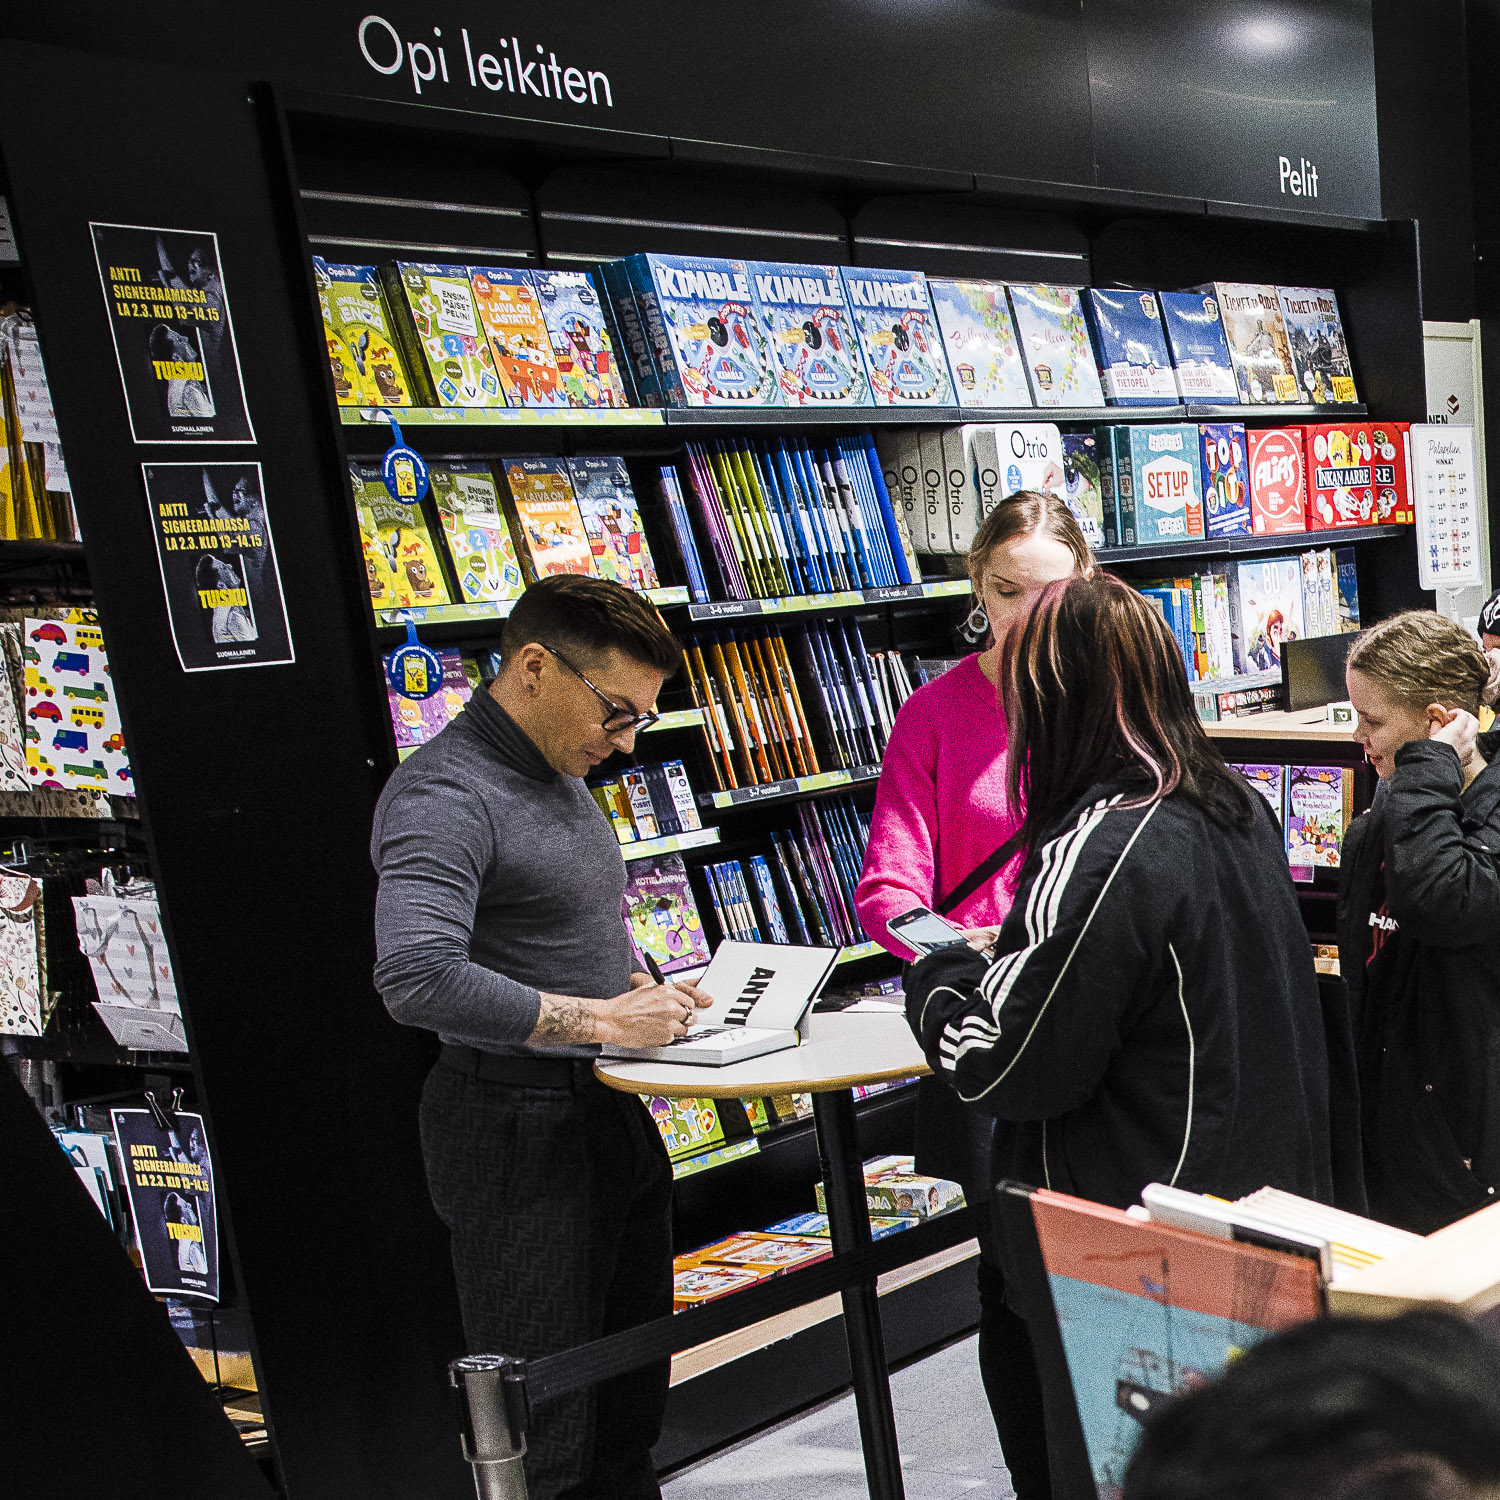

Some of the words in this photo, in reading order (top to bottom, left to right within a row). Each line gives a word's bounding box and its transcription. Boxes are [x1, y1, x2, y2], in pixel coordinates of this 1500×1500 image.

[358, 15, 450, 94] Opi
[463, 28, 614, 108] leikiten
[1278, 155, 1320, 198] Pelit
[109, 266, 142, 283] ANTTI
[683, 262, 716, 271] ORIGINAL
[780, 268, 811, 277] ORIGINAL
[655, 267, 751, 302] KIMBLE
[871, 273, 899, 281] ORIGINAL
[113, 284, 208, 304] SIGNEERAAMASSA
[754, 272, 844, 307] KIMBLE
[849, 278, 929, 309] KIMBLE
[117, 302, 131, 317] LA
[133, 303, 152, 318] 2.3.
[153, 304, 173, 319] KLO
[488, 302, 516, 314] LAIVA
[517, 304, 532, 314] ON
[1283, 297, 1309, 315] TICKET
[1317, 296, 1336, 314] RIDE
[489, 312, 536, 325] LASTATTU
[152, 360, 205, 382] TUISKU
[1116, 377, 1150, 389] TIETOPELI
[1275, 379, 1286, 399] 10
[1333, 381, 1343, 400] 10
[1010, 429, 1048, 459] Otrio
[1207, 437, 1243, 471] TOP
[1147, 470, 1189, 499] SETUP
[1318, 470, 1344, 487] INKAN
[1344, 468, 1370, 486] AARRE
[902, 466, 918, 512] Otrio
[925, 469, 941, 515] Otrio
[949, 469, 965, 516] Otrio
[159, 502, 189, 517] ANTTI
[162, 518, 251, 534] SIGNEERAAMASSA
[165, 537, 179, 551] LA
[179, 536, 199, 550] 2.3.
[199, 535, 218, 549] KLO
[1261, 562, 1280, 593] 80
[198, 588, 248, 609] TUISKU
[216, 649, 256, 658] SUOMALAINEN
[723, 966, 777, 1026] ANTTI
[130, 1144, 158, 1158] ANTTI
[132, 1159, 203, 1177] SIGNEERAAMASSA
[136, 1174, 149, 1187] LA
[150, 1174, 166, 1187] 2.3.
[166, 1175, 181, 1189] KLO
